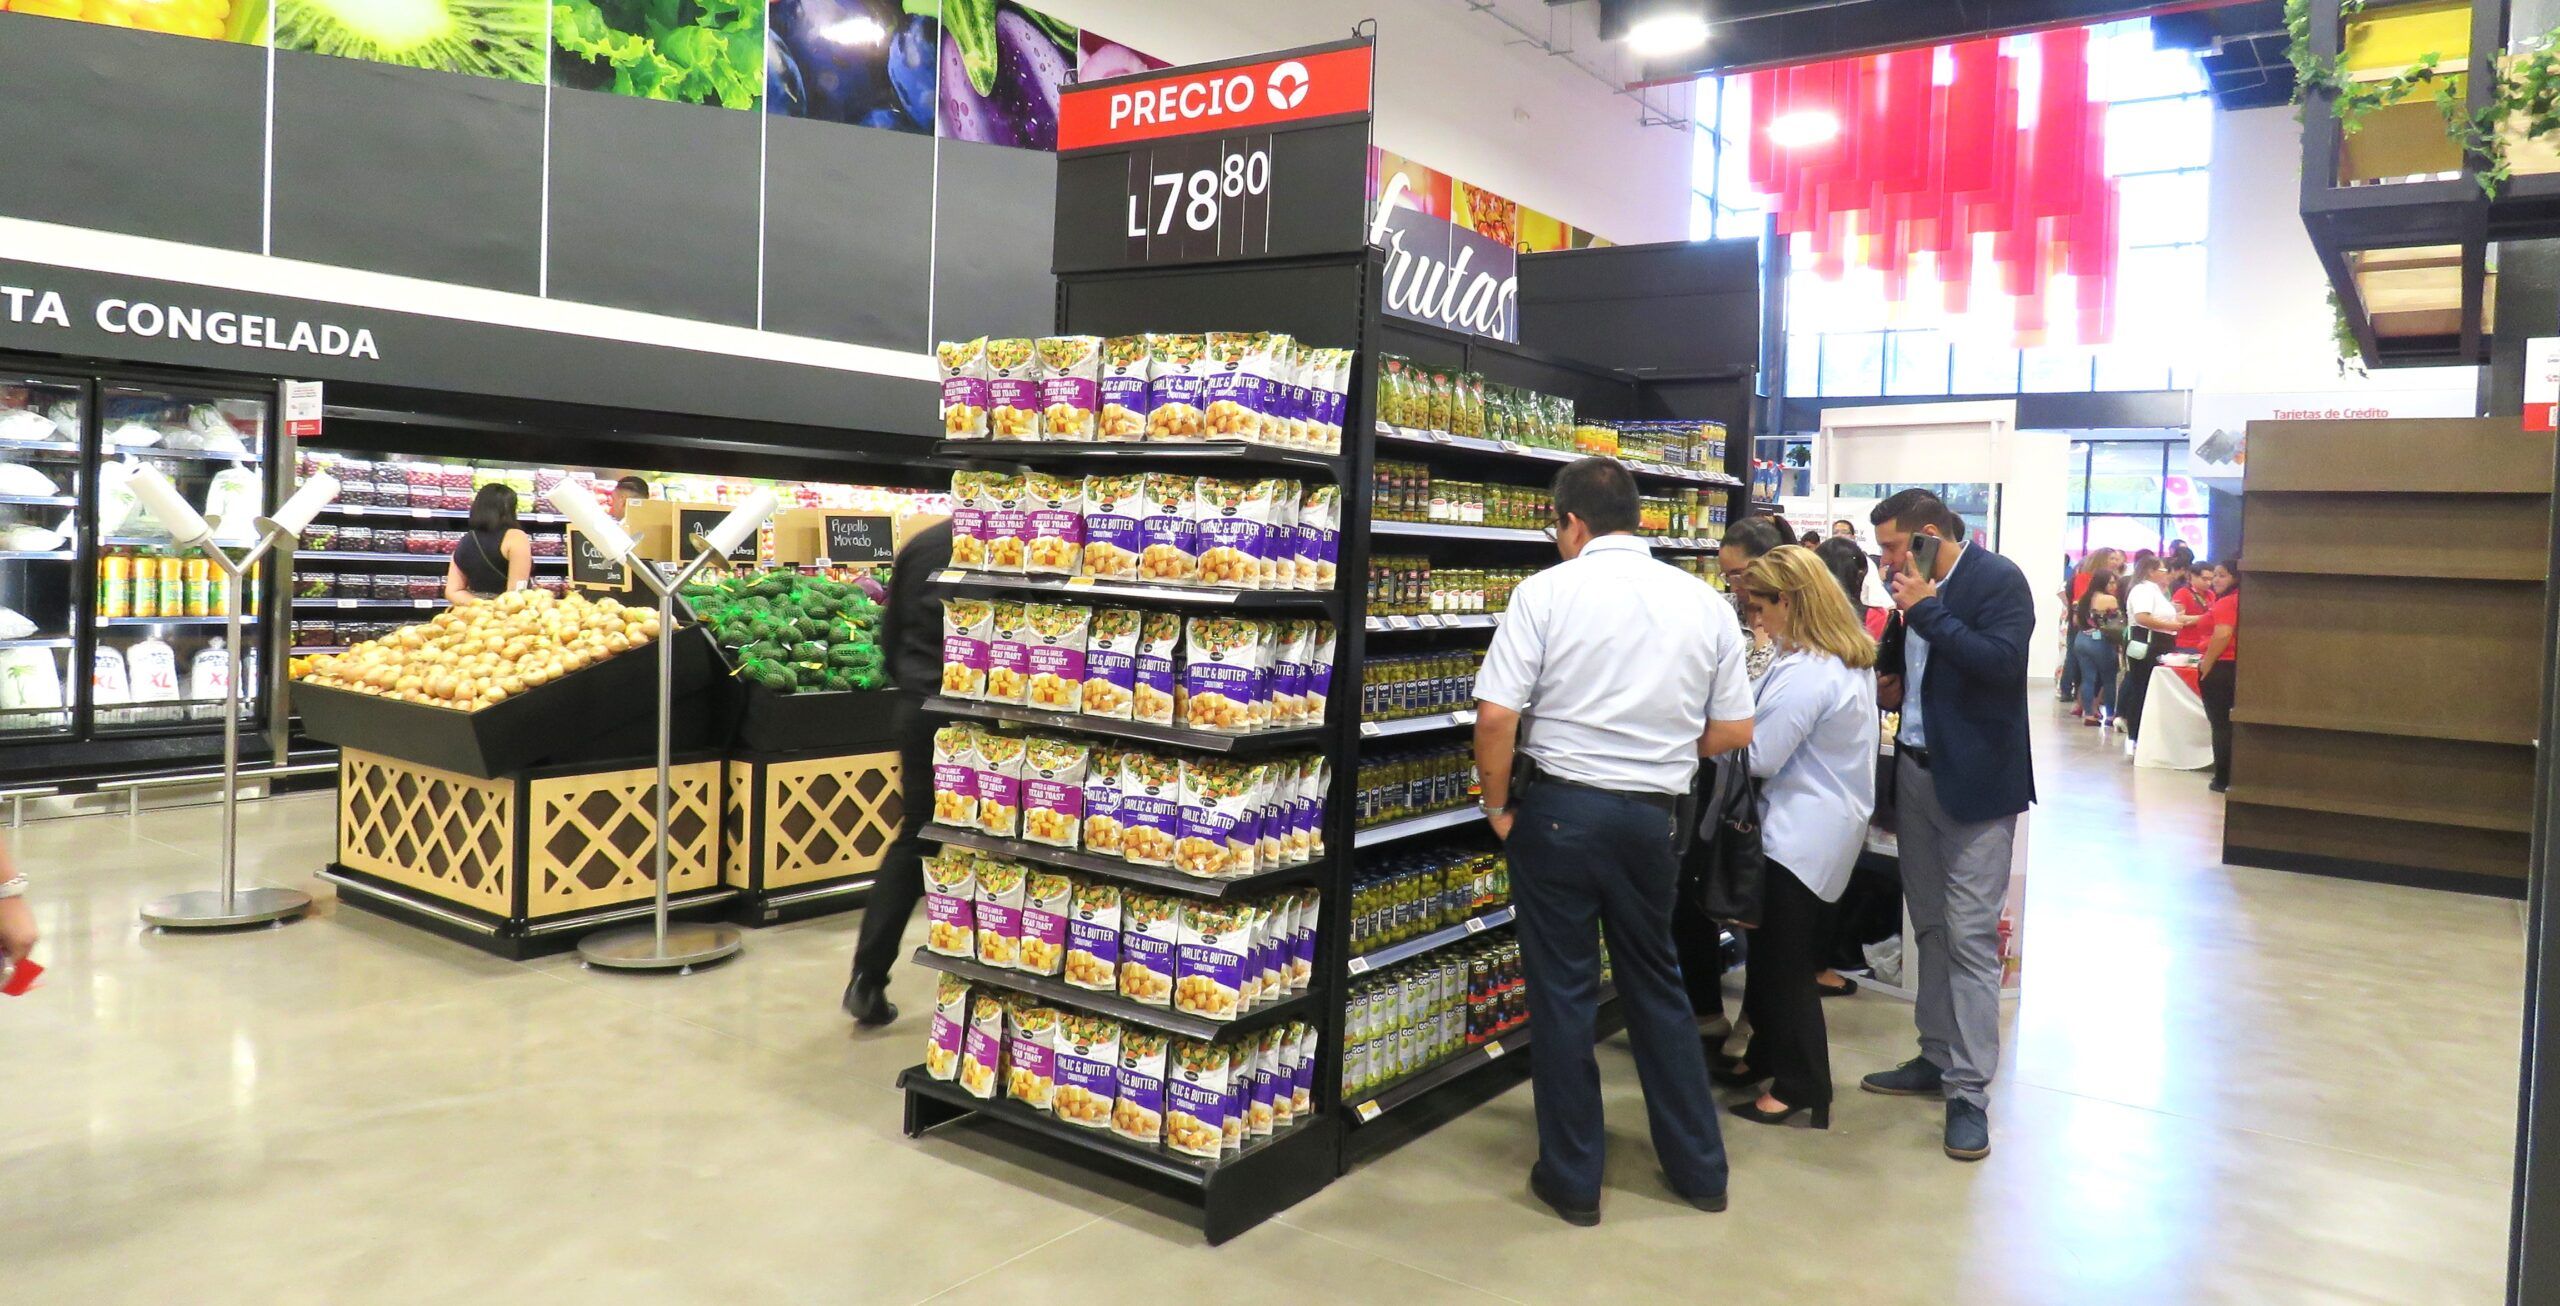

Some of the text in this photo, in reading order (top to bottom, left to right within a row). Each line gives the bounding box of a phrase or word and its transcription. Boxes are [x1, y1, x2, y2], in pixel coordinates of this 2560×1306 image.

[1109, 75, 1255, 130] PRECIO
[95, 299, 380, 360] CONGELADA
[2325, 409, 2340, 418] de
[831, 518, 869, 532] Repollo
[1108, 519, 1134, 531] BUTTER
[834, 533, 872, 547] Morado
[1105, 656, 1130, 668] BUTTER
[1148, 659, 1171, 672] BUTTER
[150, 672, 172, 689] XL
[1211, 667, 1217, 678] &
[1218, 668, 1247, 682] BUTTER
[1145, 801, 1151, 811] &
[1081, 926, 1087, 936] &
[1088, 926, 1114, 942] BUTTER
[1135, 937, 1142, 949] &
[1143, 937, 1169, 954] BUTTER
[1202, 949, 1208, 961] &
[1209, 950, 1238, 967] BUTTER
[1075, 1060, 1081, 1072] &
[1082, 1062, 1111, 1077] BUTTER
[1132, 1074, 1158, 1091] BUTTER
[1185, 1086, 1190, 1099] &
[1190, 1088, 1220, 1106] BUTTER
